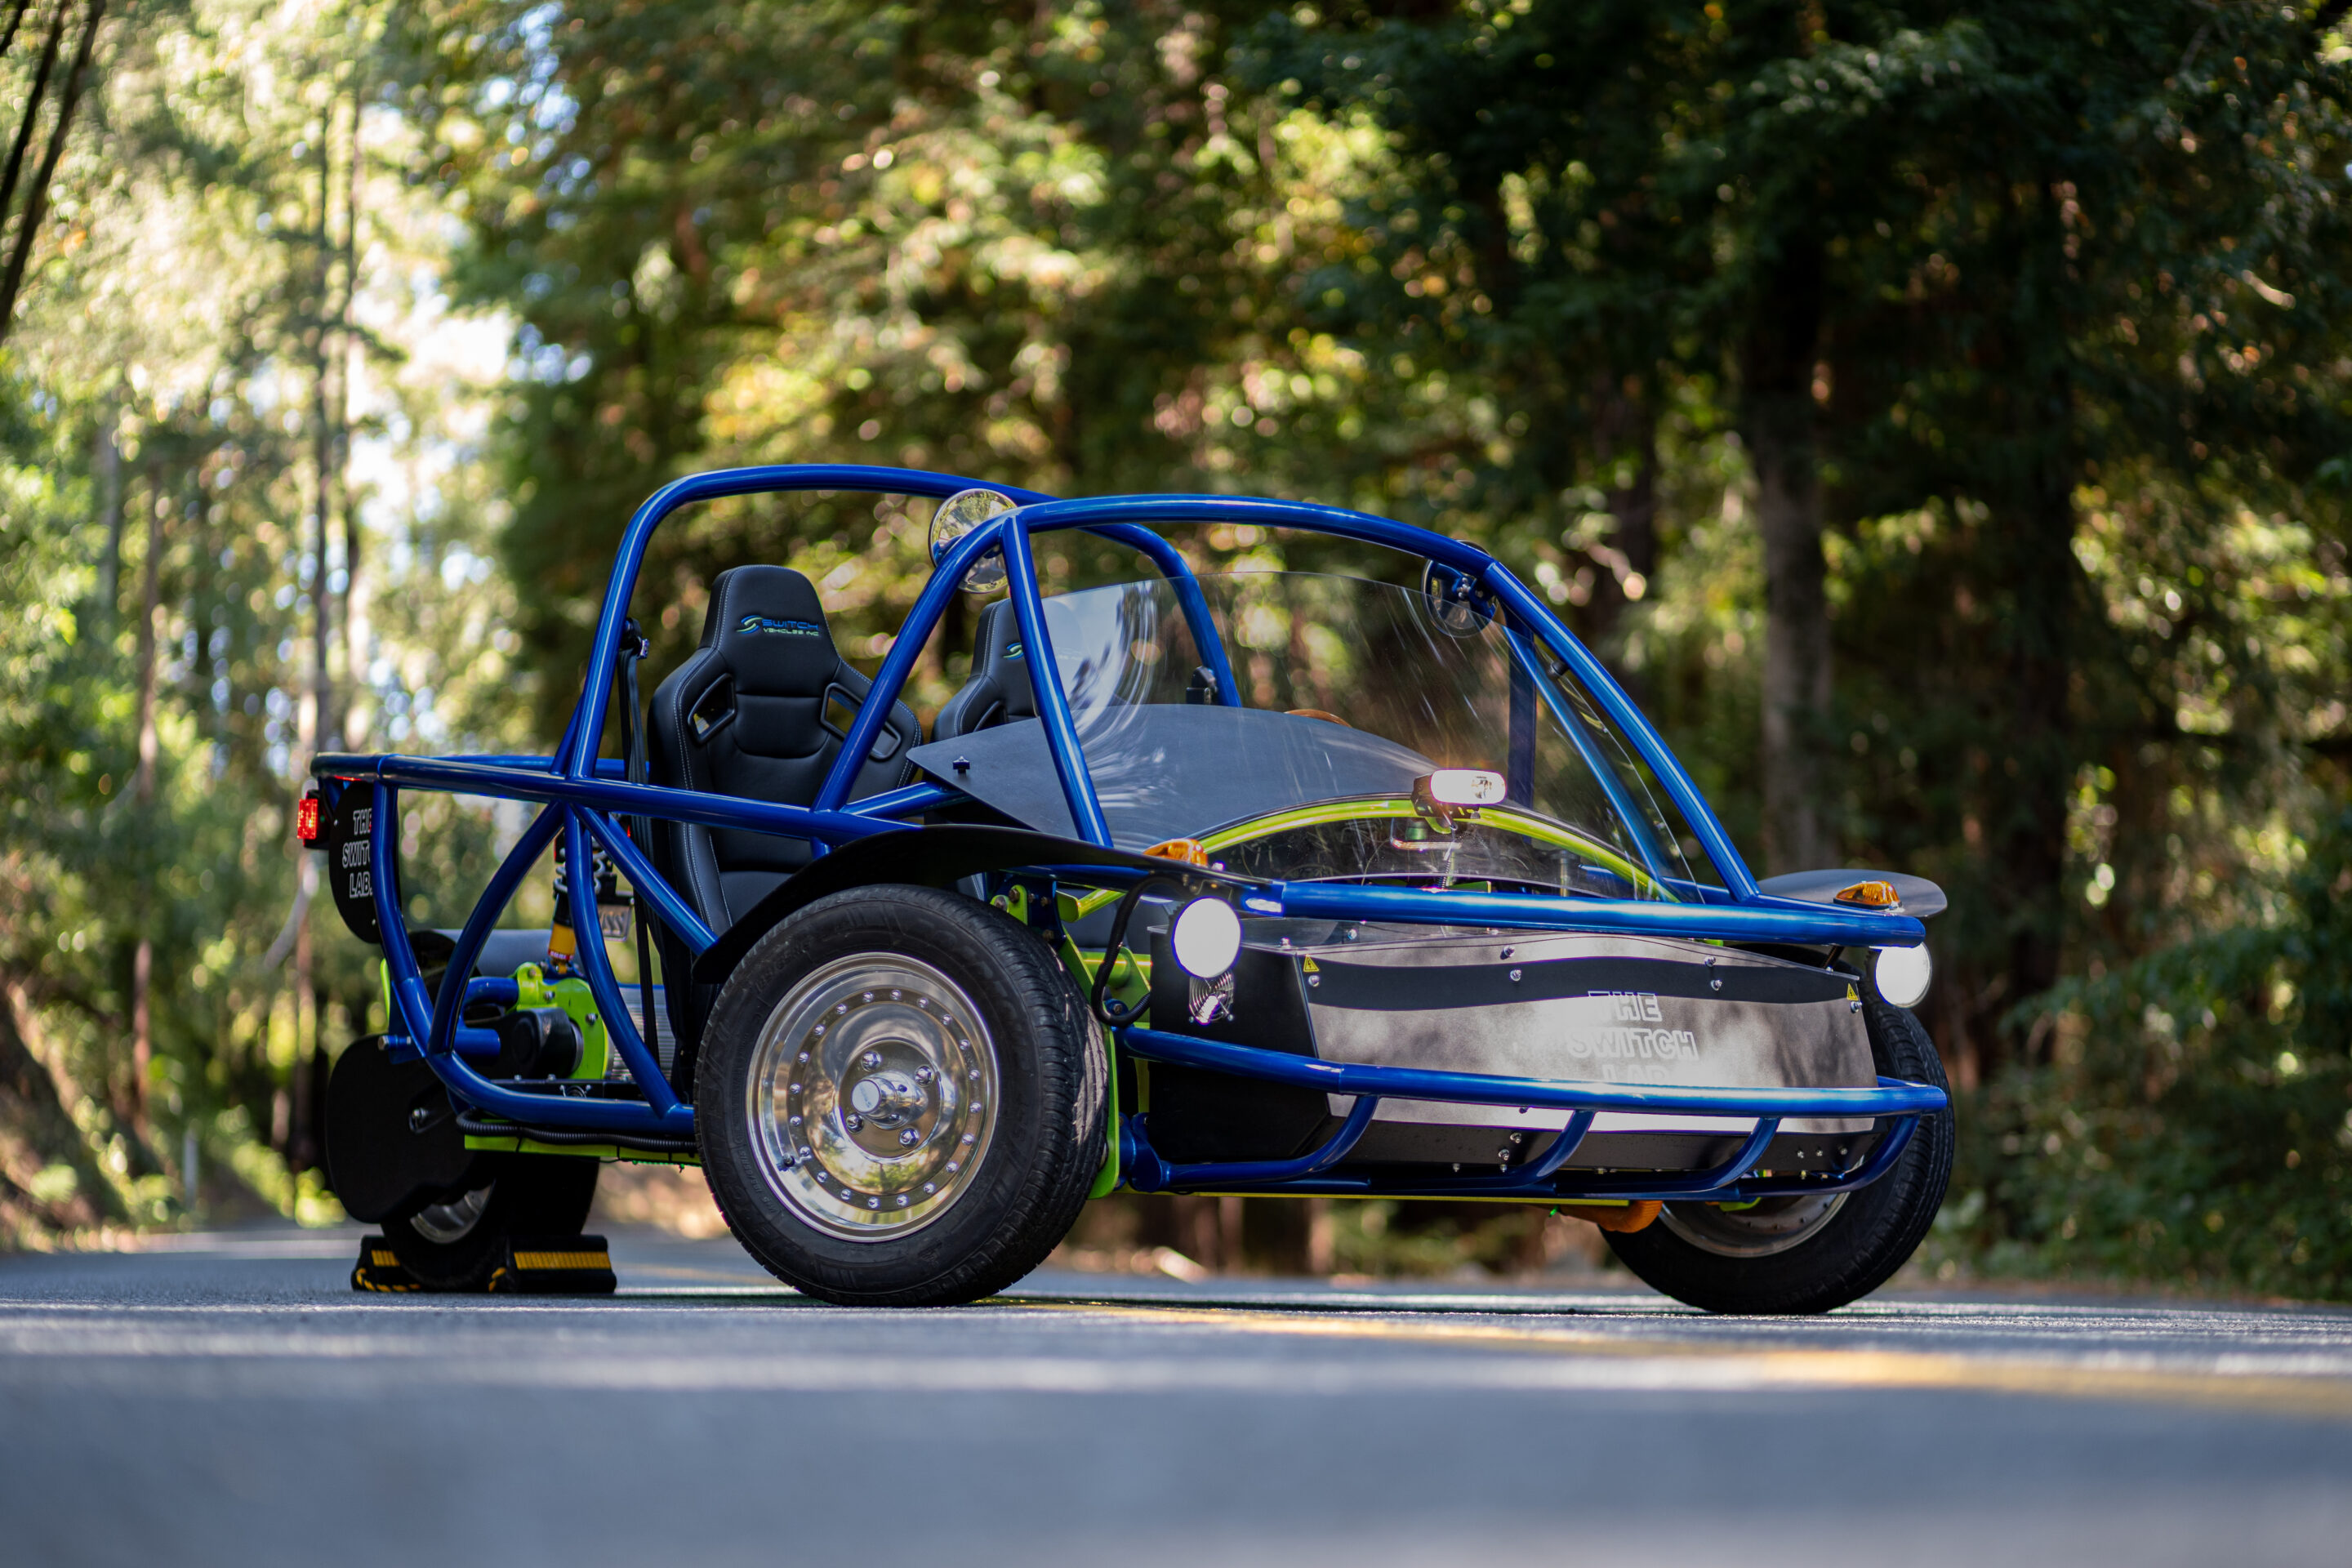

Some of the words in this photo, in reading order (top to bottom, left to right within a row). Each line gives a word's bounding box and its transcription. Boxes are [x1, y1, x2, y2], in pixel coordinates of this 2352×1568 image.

[762, 619, 819, 630] SWITCH
[342, 840, 371, 868] SWIT
[1588, 991, 1663, 1022] THE
[1566, 1027, 1699, 1061] SWITCH
